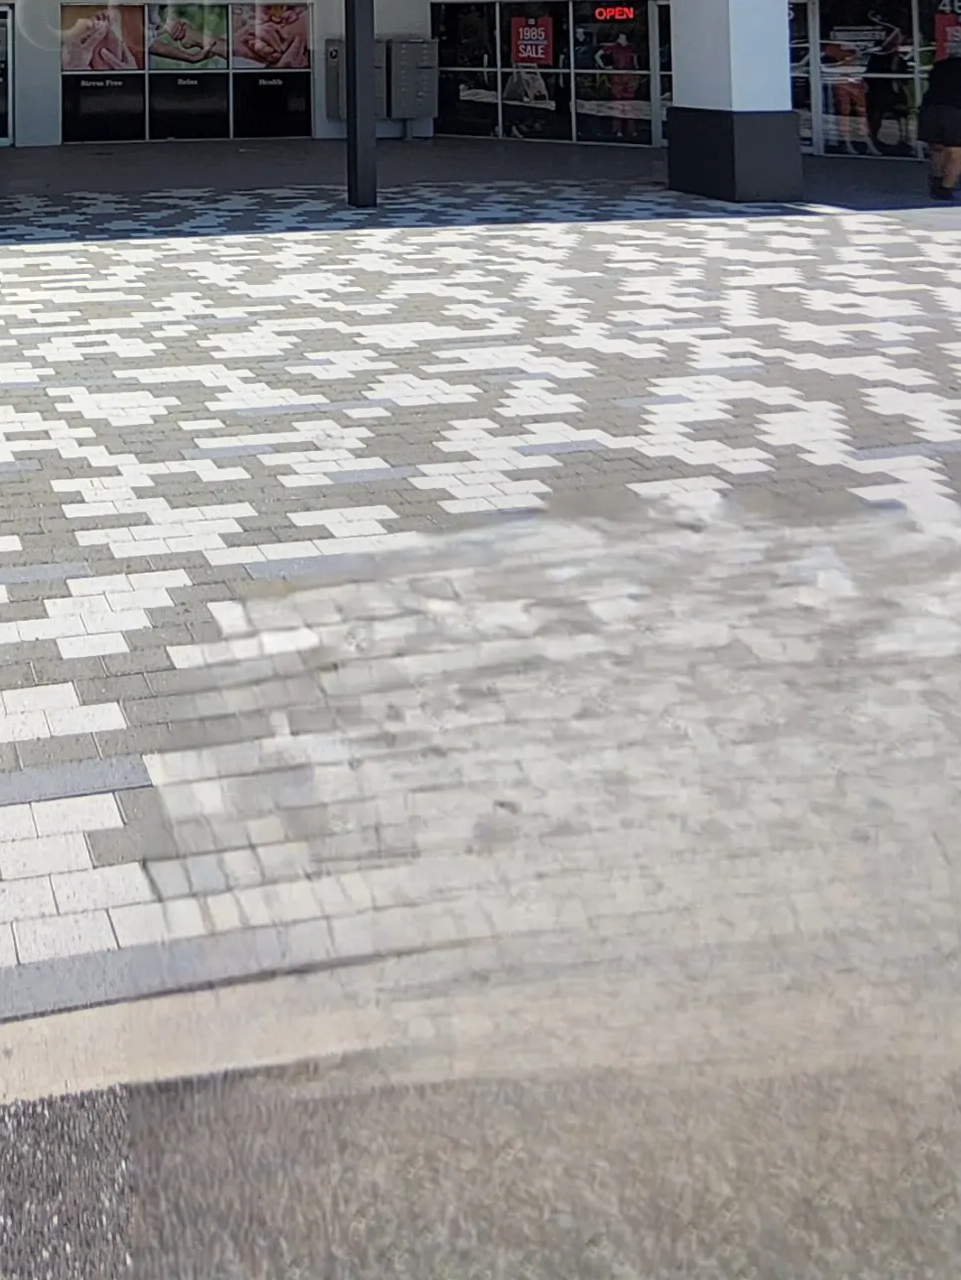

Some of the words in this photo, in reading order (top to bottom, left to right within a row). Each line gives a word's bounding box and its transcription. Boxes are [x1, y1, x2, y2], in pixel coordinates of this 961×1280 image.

[594, 7, 635, 20] OPEN
[518, 27, 546, 40] 1985
[518, 45, 546, 58] SALE
